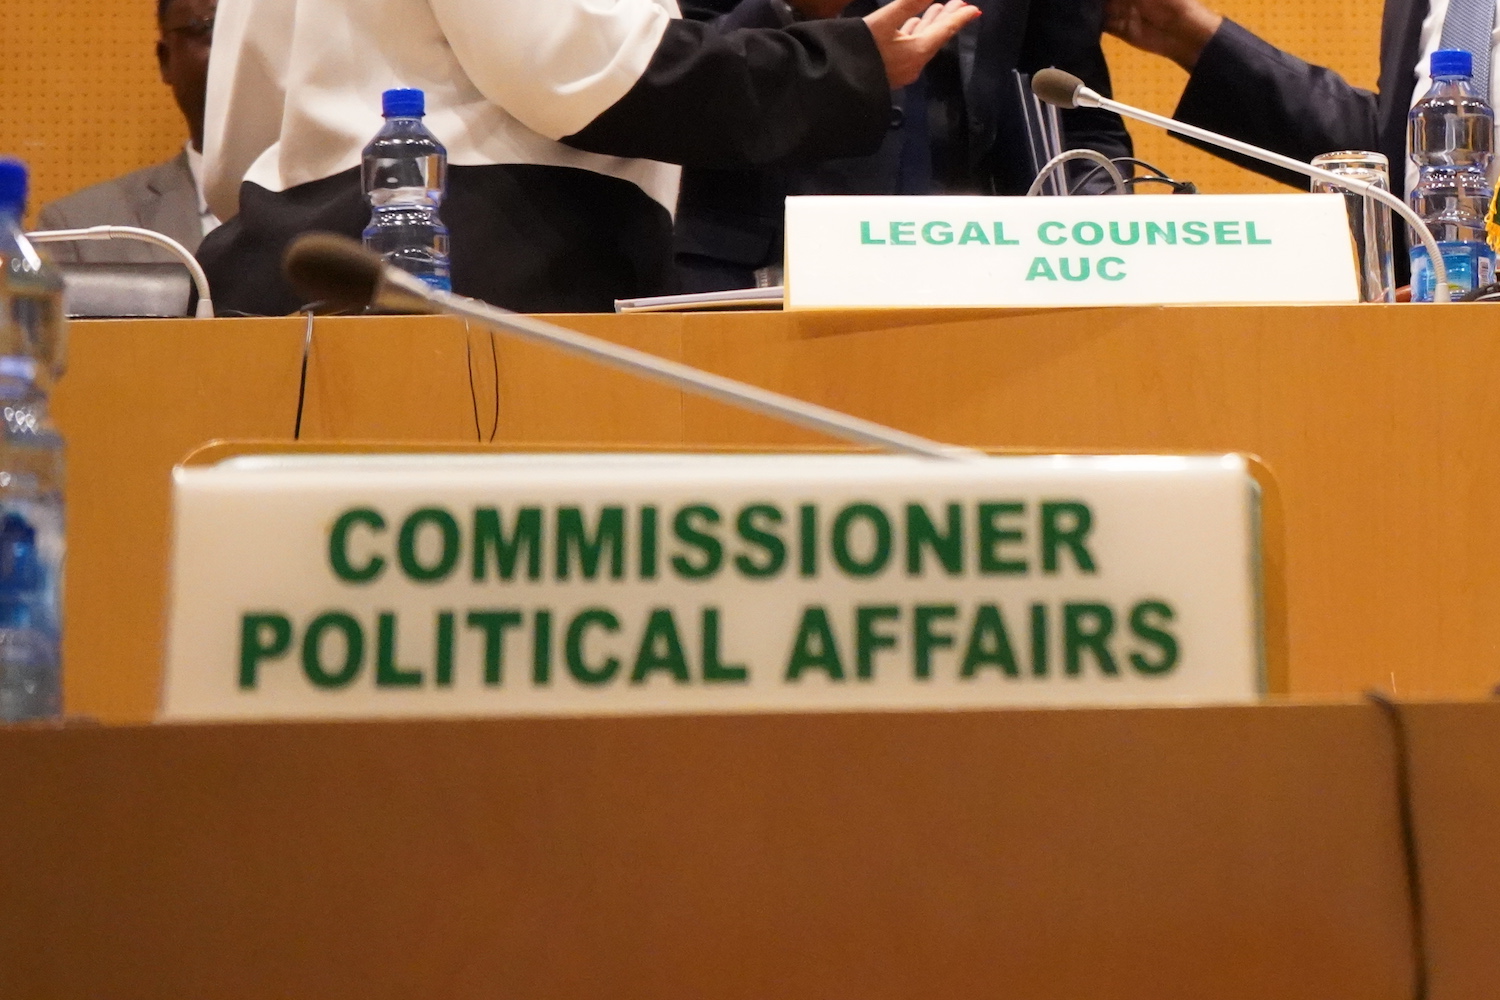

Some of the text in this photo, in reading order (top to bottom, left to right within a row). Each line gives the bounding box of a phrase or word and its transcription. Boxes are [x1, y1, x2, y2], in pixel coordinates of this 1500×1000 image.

[859, 219, 1273, 246] LEGAL COUNSEL
[1024, 255, 1128, 282] AUC
[326, 498, 1099, 584] COMMISSIONER
[238, 598, 1180, 689] POLITICAL AFFAIRS
